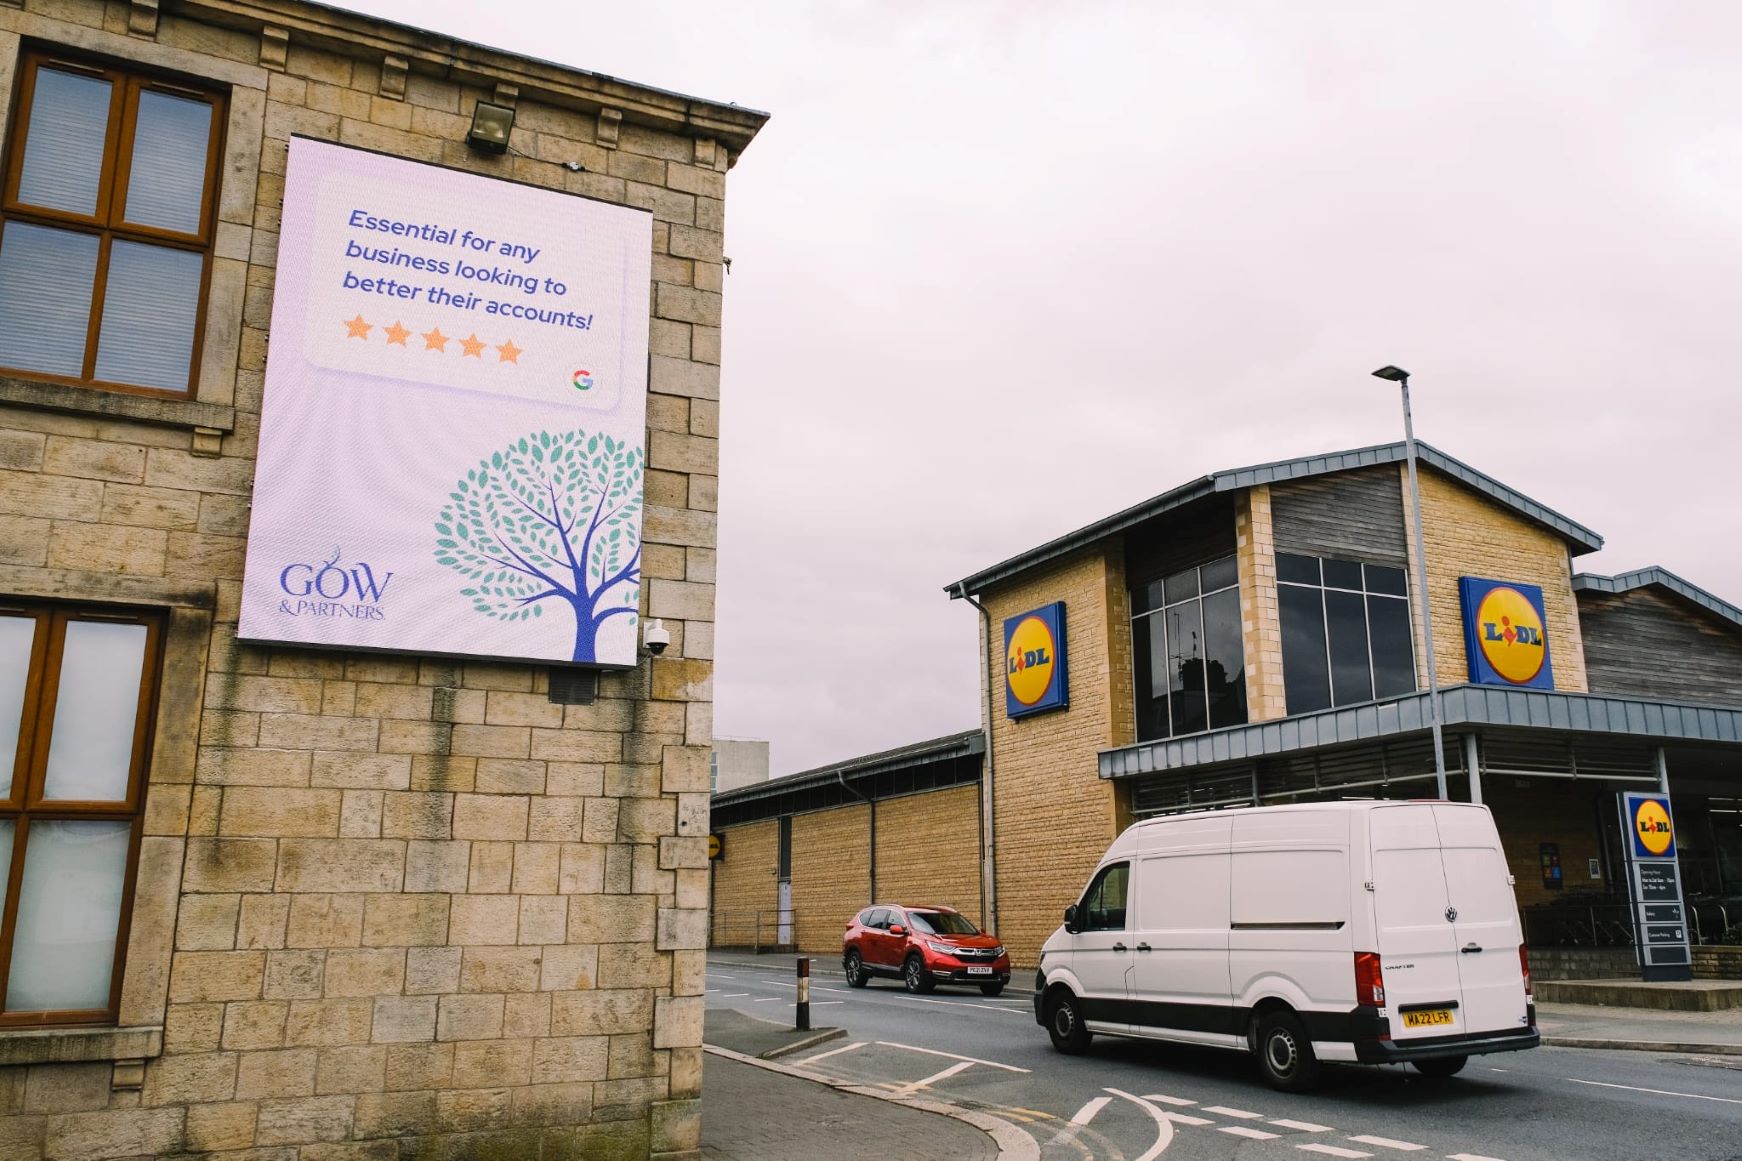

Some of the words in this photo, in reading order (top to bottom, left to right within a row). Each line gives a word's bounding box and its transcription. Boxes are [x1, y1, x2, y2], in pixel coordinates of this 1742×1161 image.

[349, 209, 457, 245] Essential
[461, 230, 496, 252] for
[499, 242, 541, 264] any
[345, 239, 450, 275] business
[454, 260, 539, 295] looking
[544, 277, 567, 296] to
[343, 270, 423, 300] better
[428, 286, 482, 311] their
[485, 300, 593, 331] accounts!
[280, 561, 394, 603] GOW
[298, 600, 386, 621] PARTNERS
